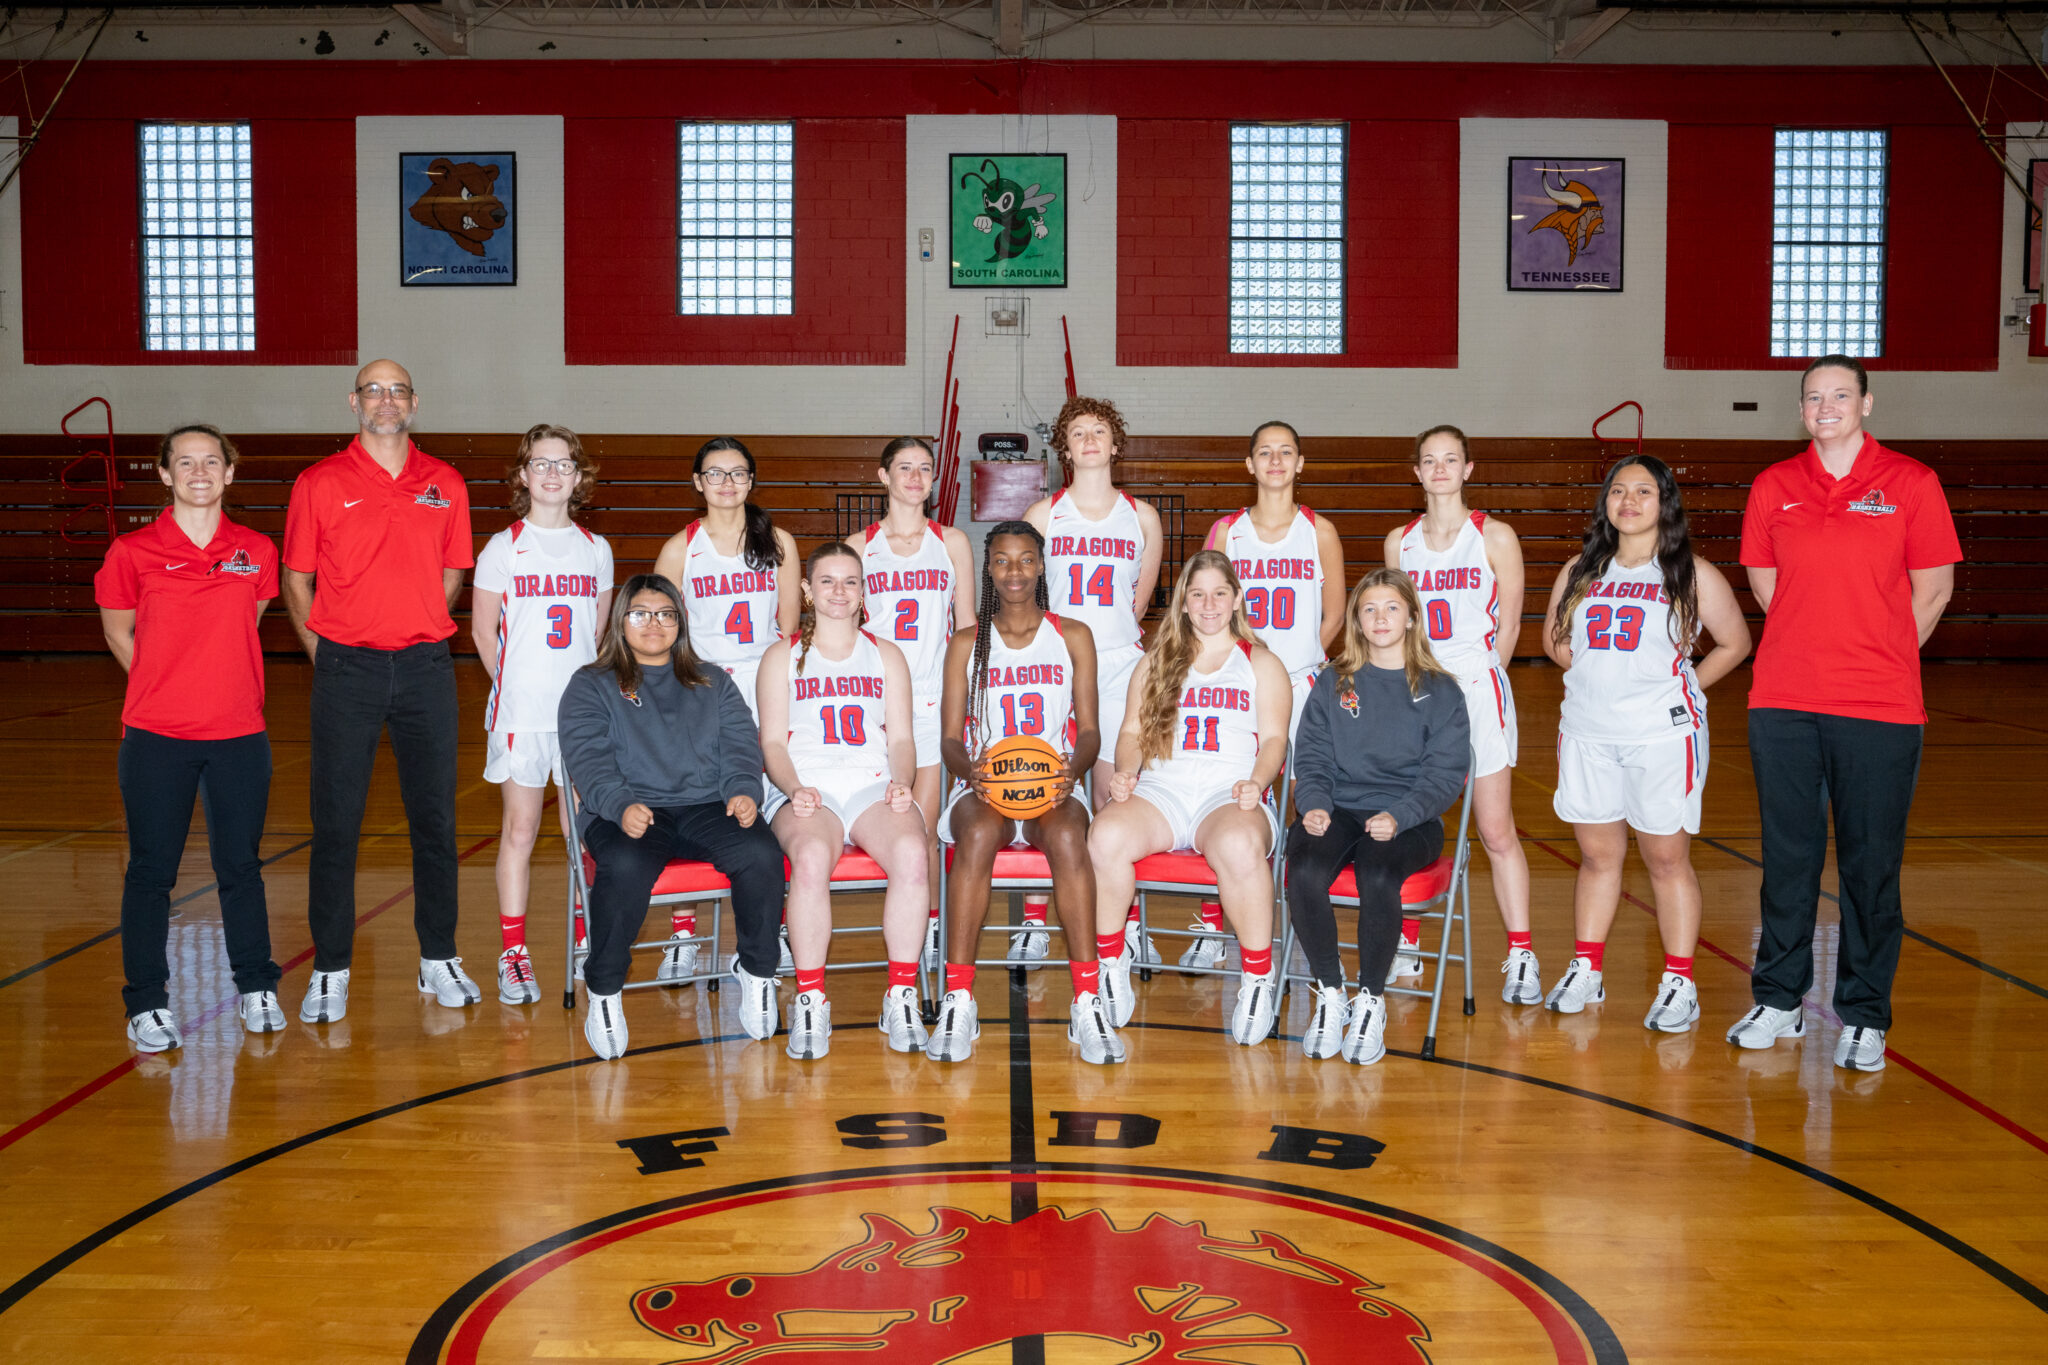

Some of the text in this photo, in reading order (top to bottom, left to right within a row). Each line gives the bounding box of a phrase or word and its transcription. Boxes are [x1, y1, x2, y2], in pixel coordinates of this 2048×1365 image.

[408, 265, 509, 274] NORTH CAROLINA
[957, 269, 1060, 278] SOUTH CAROLINA
[1521, 271, 1611, 283] TENNESSEE
[1050, 536, 1136, 560] DRAGONS
[513, 574, 598, 598] DRAGONS
[691, 570, 776, 598] DRAGONS
[866, 568, 949, 595] DRAGONS
[1068, 563, 1114, 606] 14
[1407, 567, 1481, 591] RAGONS
[894, 598, 919, 641] 2
[1245, 586, 1296, 630] 30
[1426, 598, 1453, 641] 0
[546, 604, 573, 649] 3
[724, 600, 754, 644] 4
[1585, 604, 1646, 652] 23
[794, 676, 883, 701] DRAGONS
[981, 664, 1064, 689] RAGONS
[819, 704, 867, 746] 10
[1000, 692, 1045, 738] 13
[1182, 715, 1220, 752] 11
[992, 757, 1051, 776] Wilson
[1002, 786, 1046, 801] NCAA
